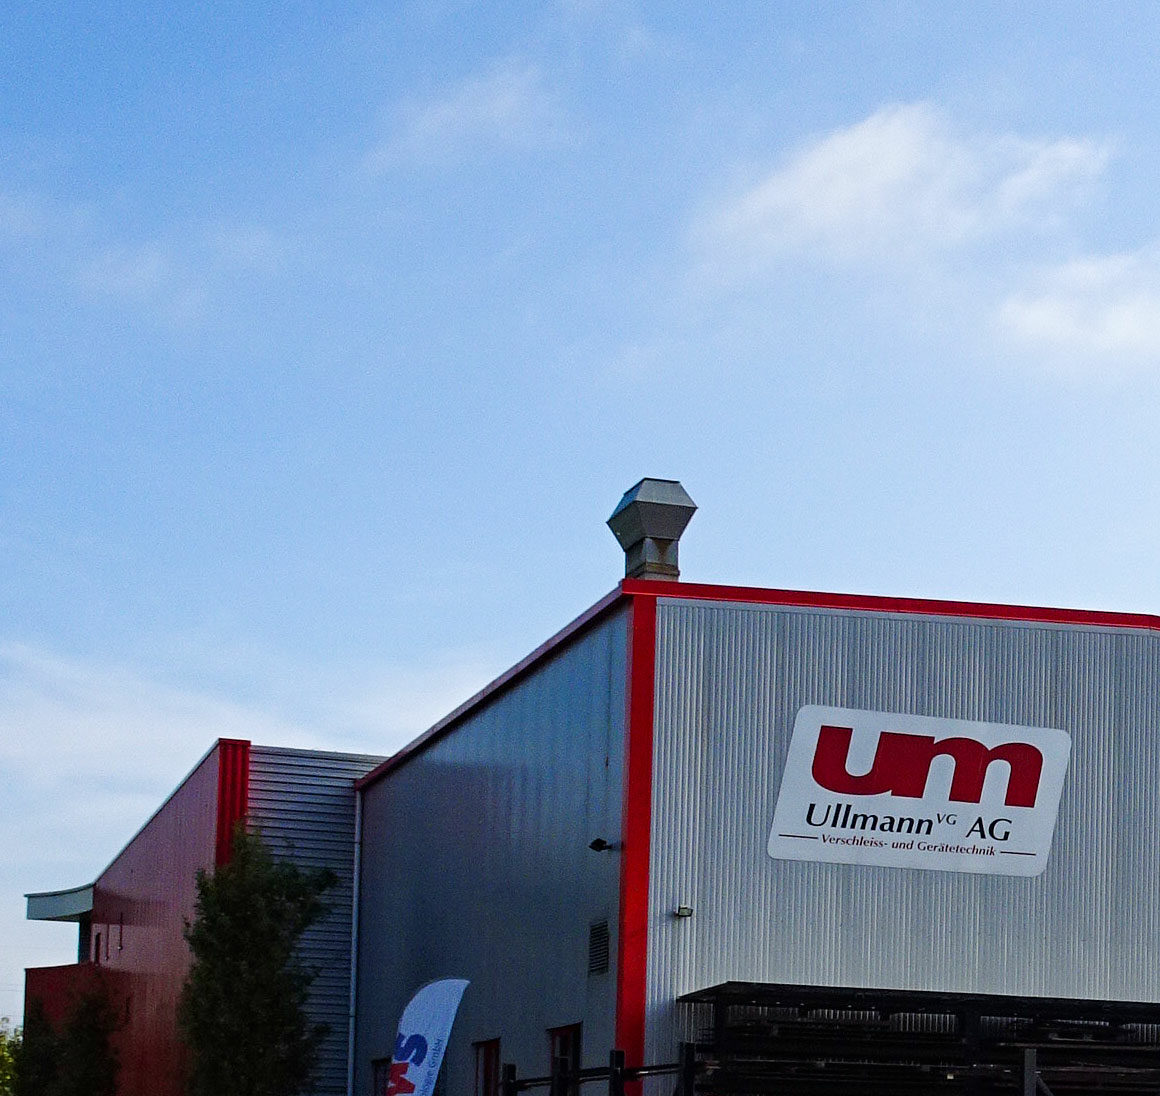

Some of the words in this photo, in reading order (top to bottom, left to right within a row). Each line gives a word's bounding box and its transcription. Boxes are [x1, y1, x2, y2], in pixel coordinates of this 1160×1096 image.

[811, 725, 1044, 808] um
[966, 816, 1012, 842] AG
[821, 833, 888, 848] Verschleiss-
[891, 838, 914, 851] und
[917, 839, 996, 857] Gerätetechnik
